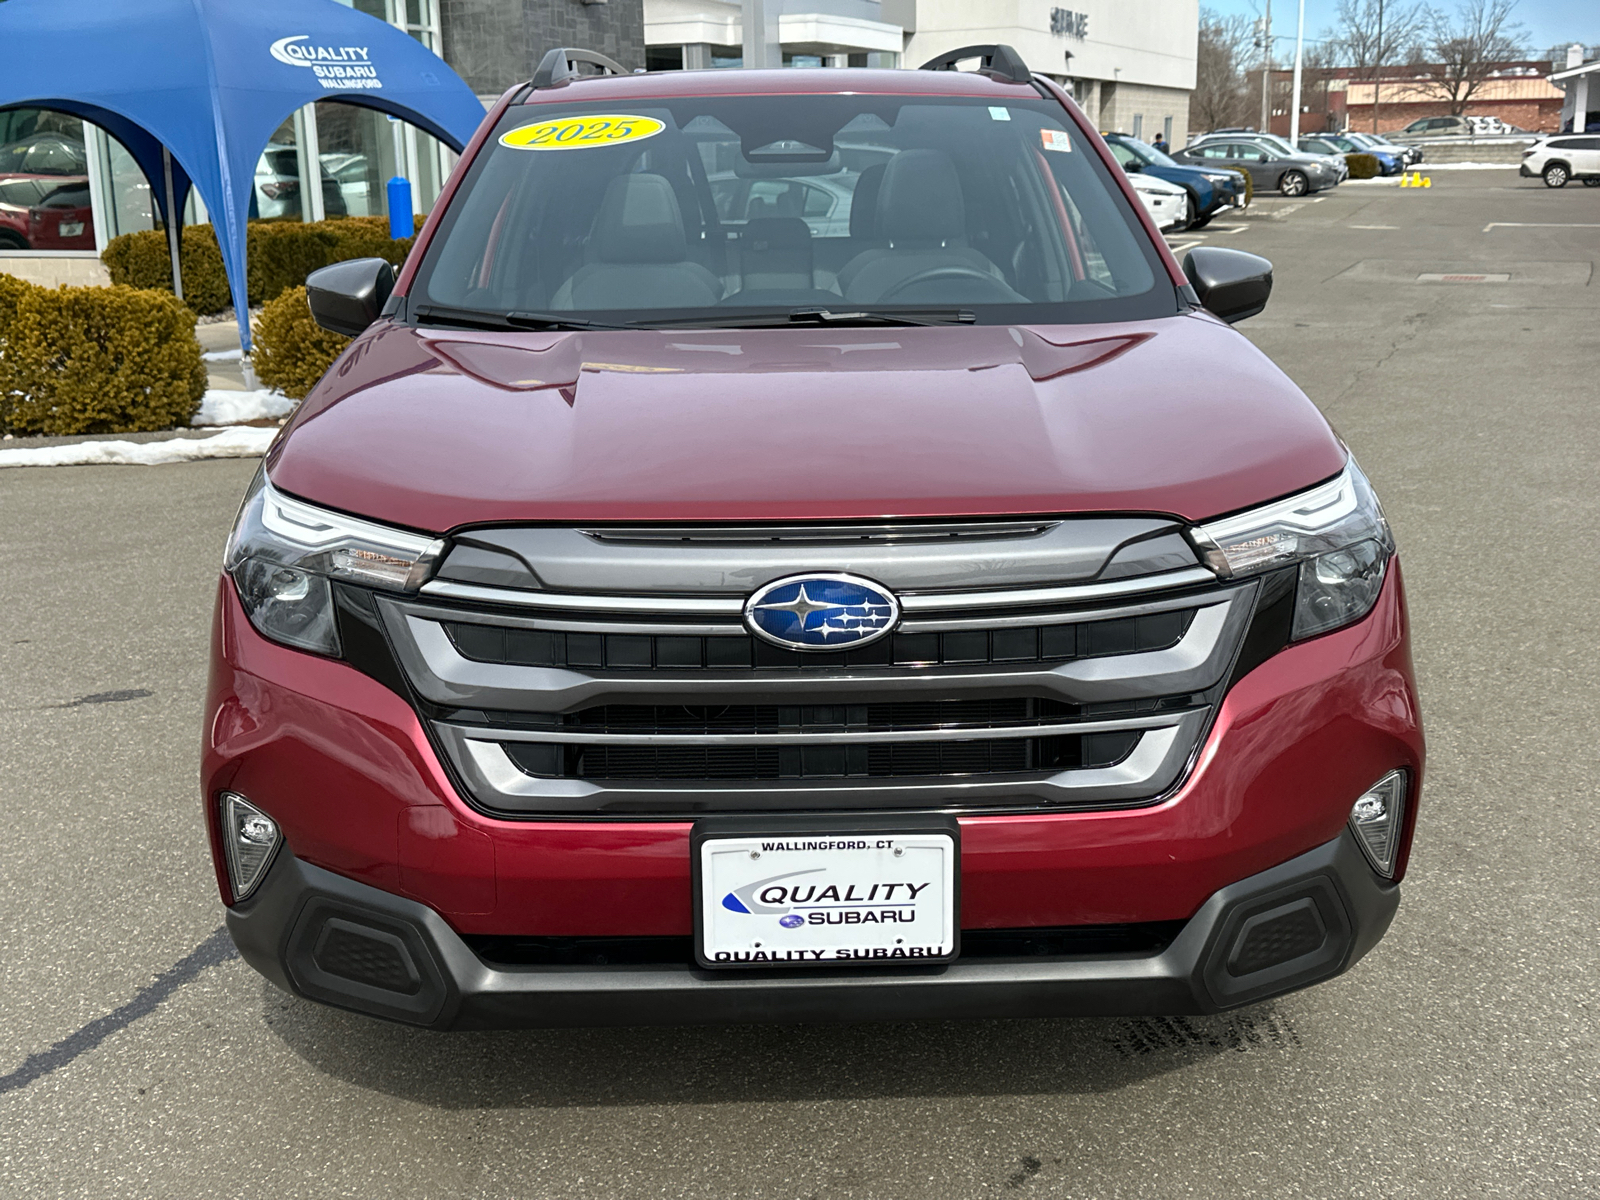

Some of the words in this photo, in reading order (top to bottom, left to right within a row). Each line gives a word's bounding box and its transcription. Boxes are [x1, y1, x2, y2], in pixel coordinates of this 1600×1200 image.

[286, 44, 368, 60] QUALITY
[312, 65, 377, 78] SUBARU
[318, 78, 383, 89] WALLINGFORD
[526, 120, 640, 145] 2025
[761, 841, 871, 852] WALLINGFORD,
[875, 840, 895, 850] CT
[759, 882, 931, 904] QUALITY
[807, 910, 916, 925] SUBARU
[714, 949, 827, 963] QUALITY
[835, 946, 944, 960] SUBARU
